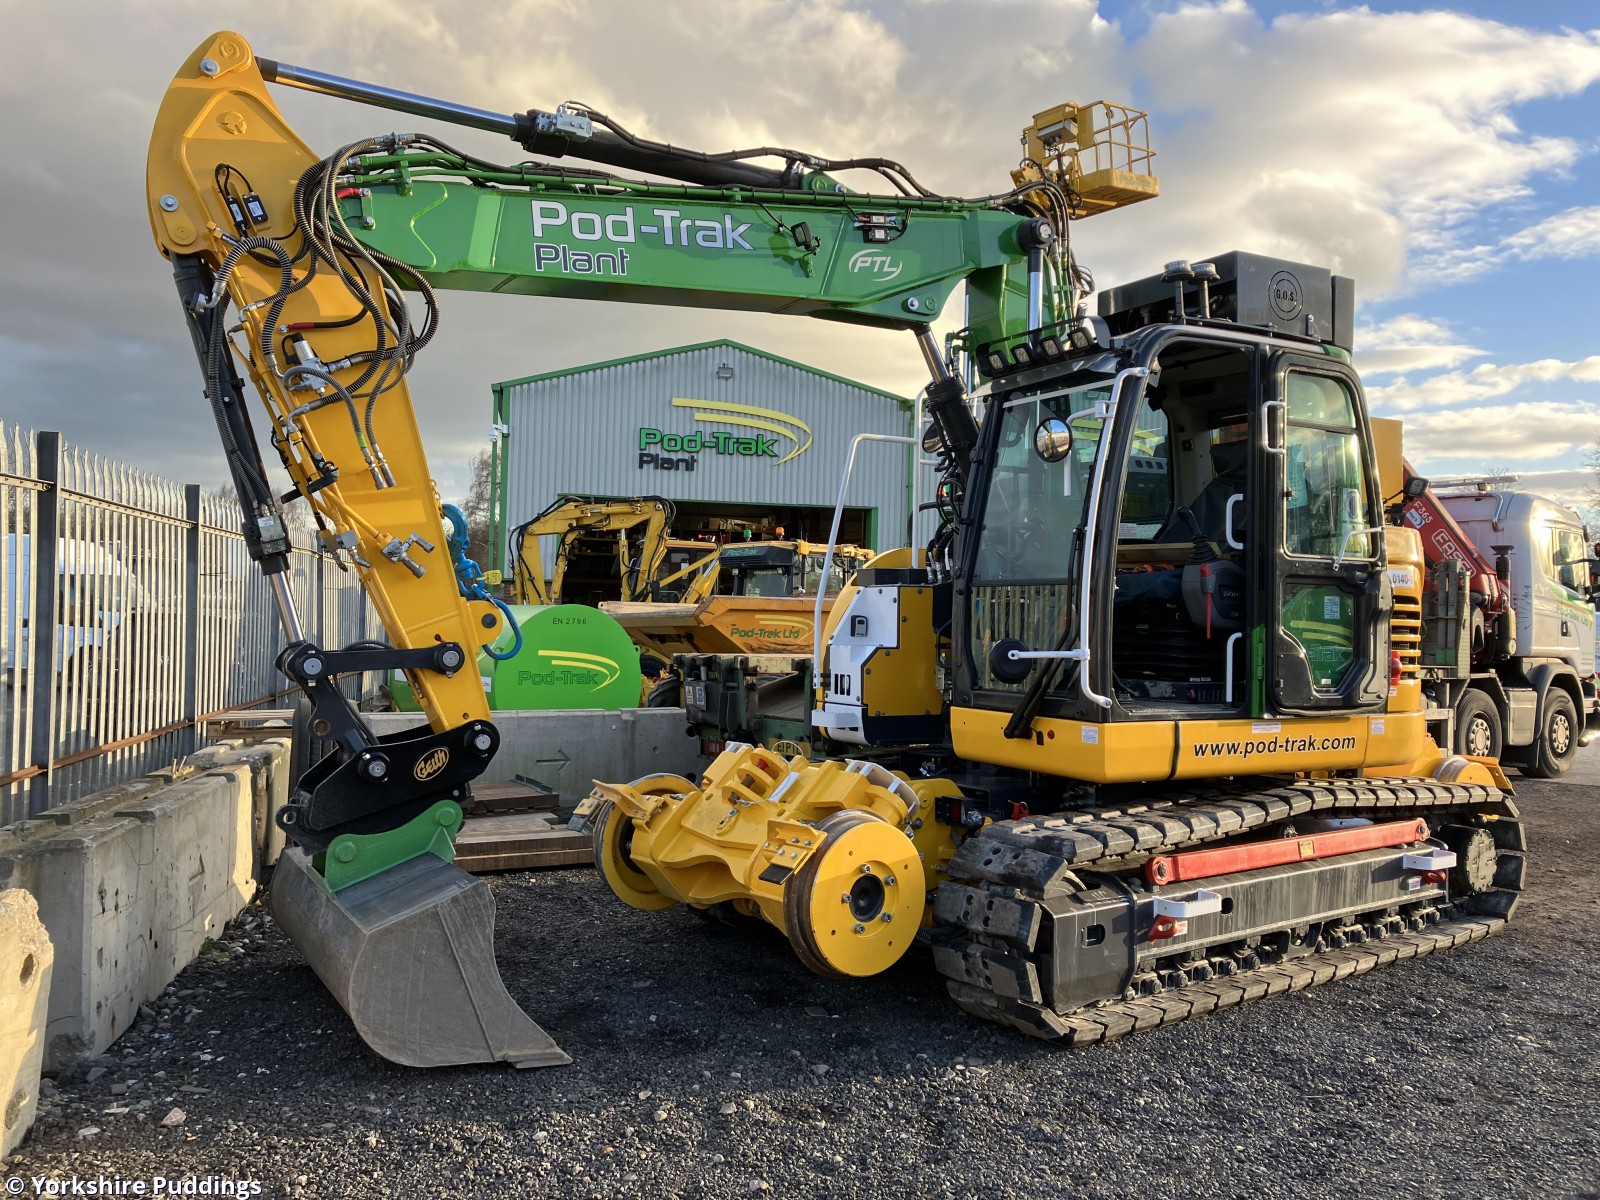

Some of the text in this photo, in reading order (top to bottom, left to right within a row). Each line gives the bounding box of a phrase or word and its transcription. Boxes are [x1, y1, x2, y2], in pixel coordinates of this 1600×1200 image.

[531, 199, 755, 251] Pod-Trak
[534, 243, 630, 276] Plant
[853, 256, 898, 273] PTL
[639, 427, 779, 458] Pod-Trak
[638, 452, 698, 472] Plant
[1413, 500, 1434, 523] F365
[552, 617, 587, 625] EN 2796
[730, 627, 800, 639] Pod-Trak Ltd
[518, 670, 599, 686] Pod-Trak
[1193, 734, 1356, 759] www.pod-trak.com
